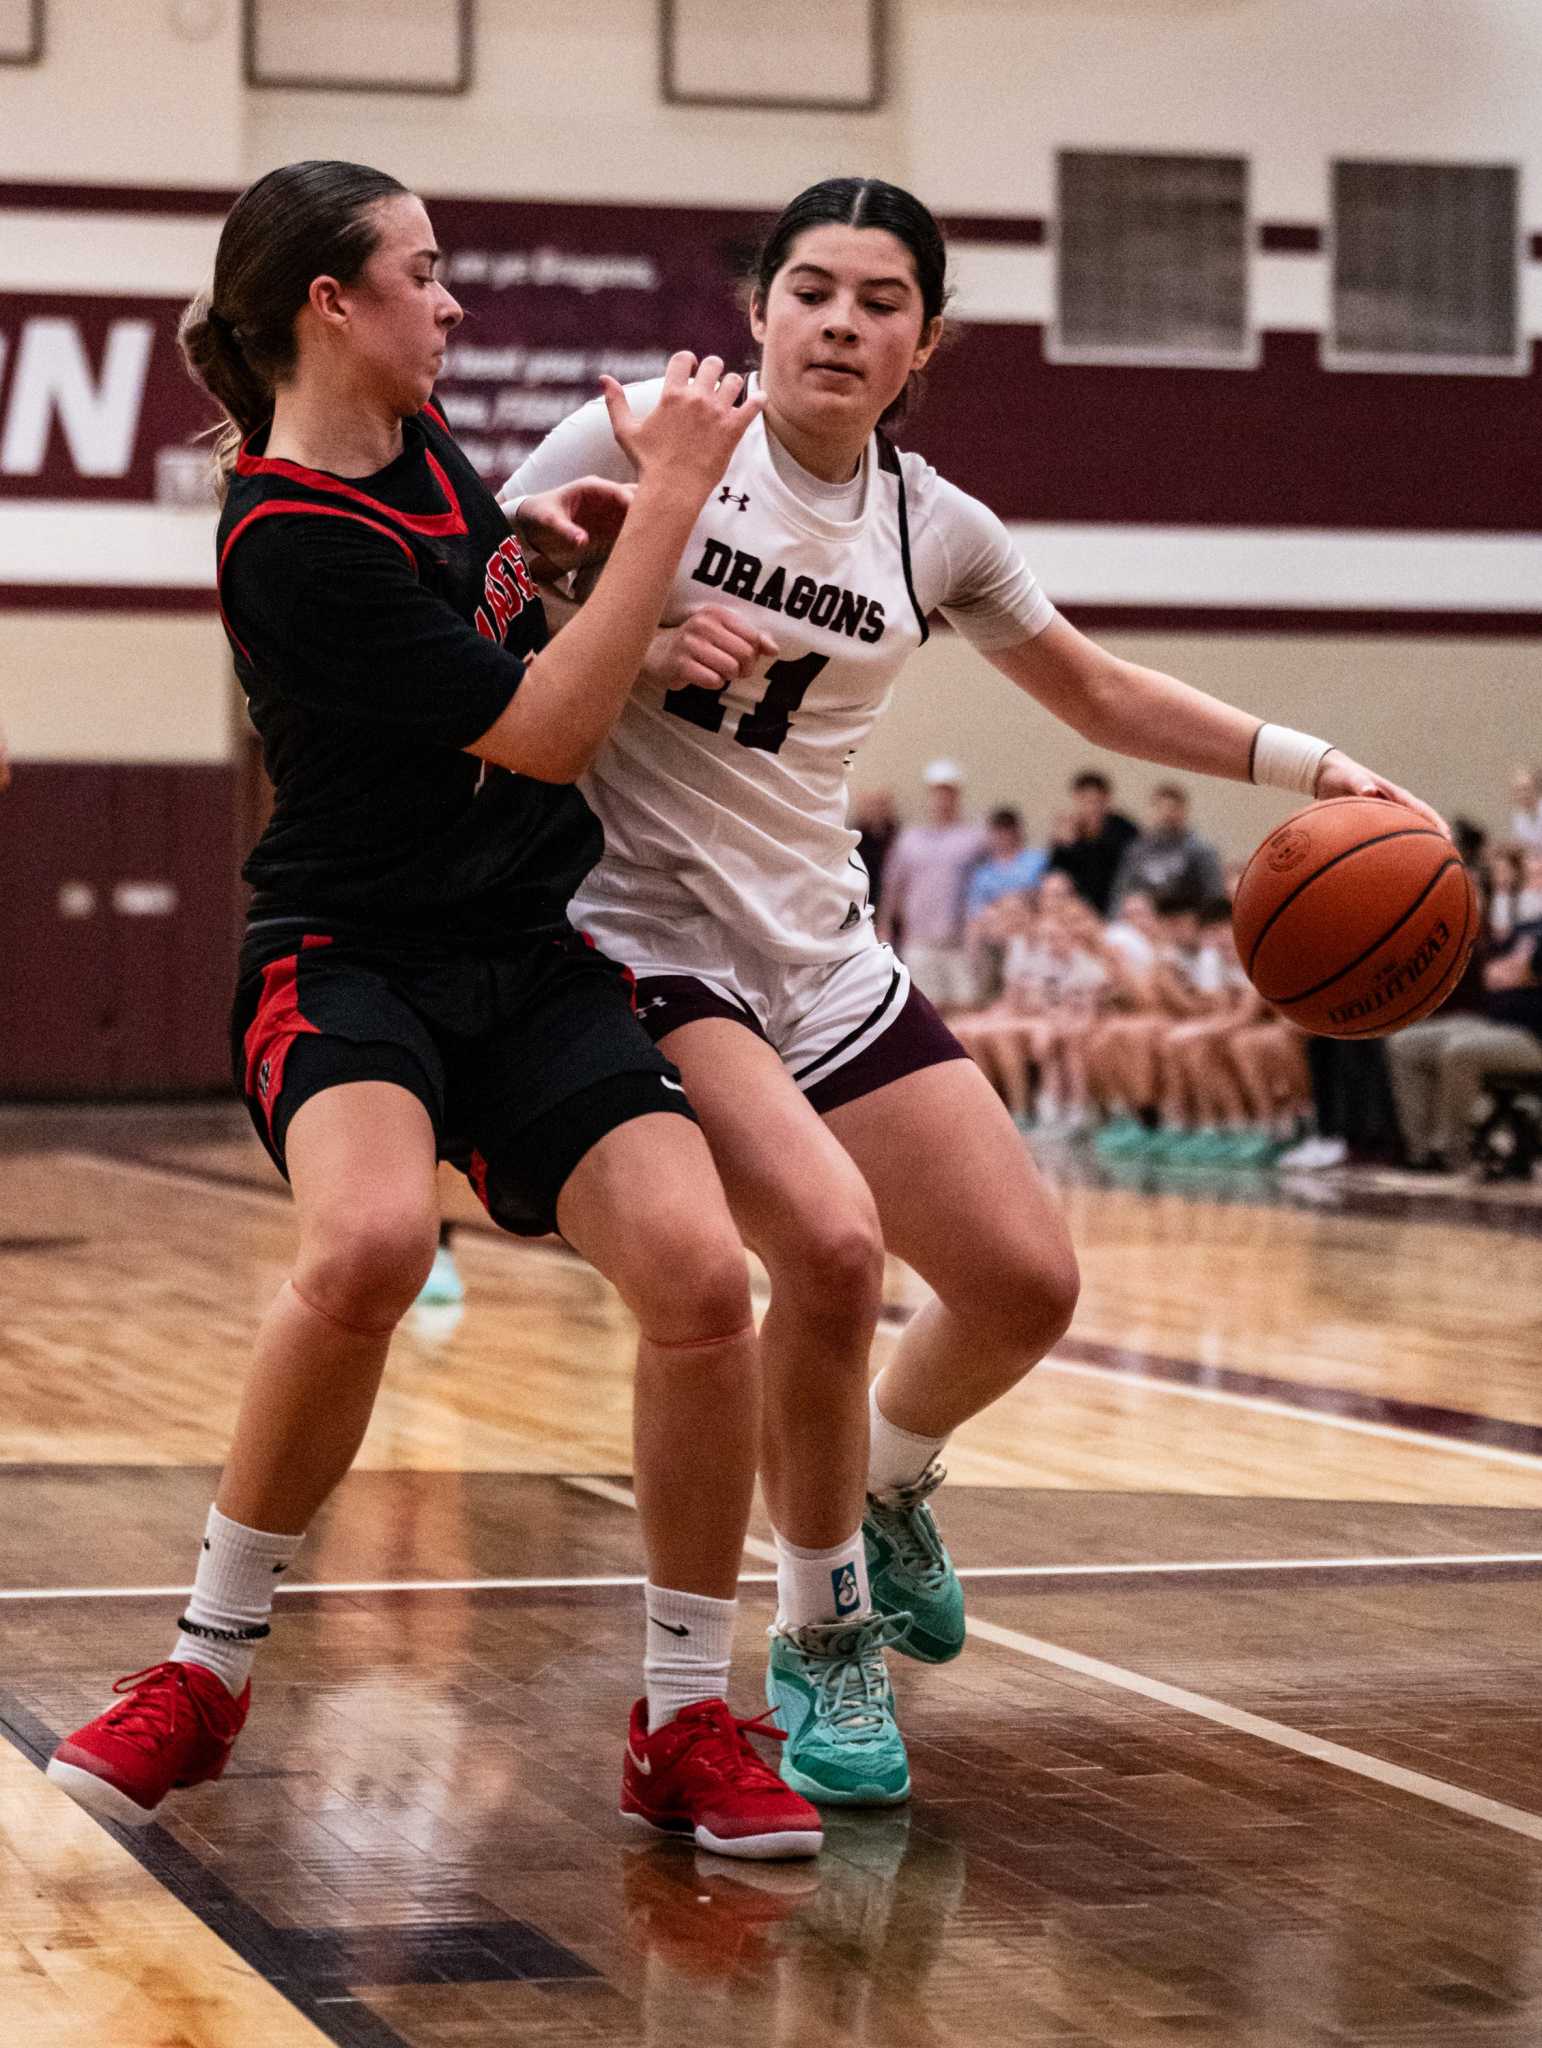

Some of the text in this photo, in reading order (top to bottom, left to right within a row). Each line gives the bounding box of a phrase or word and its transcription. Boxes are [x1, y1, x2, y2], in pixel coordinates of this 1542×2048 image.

[0, 318, 154, 479] N
[691, 538, 886, 644] DRAGONS
[1328, 921, 1449, 1023] EVOLUTION
